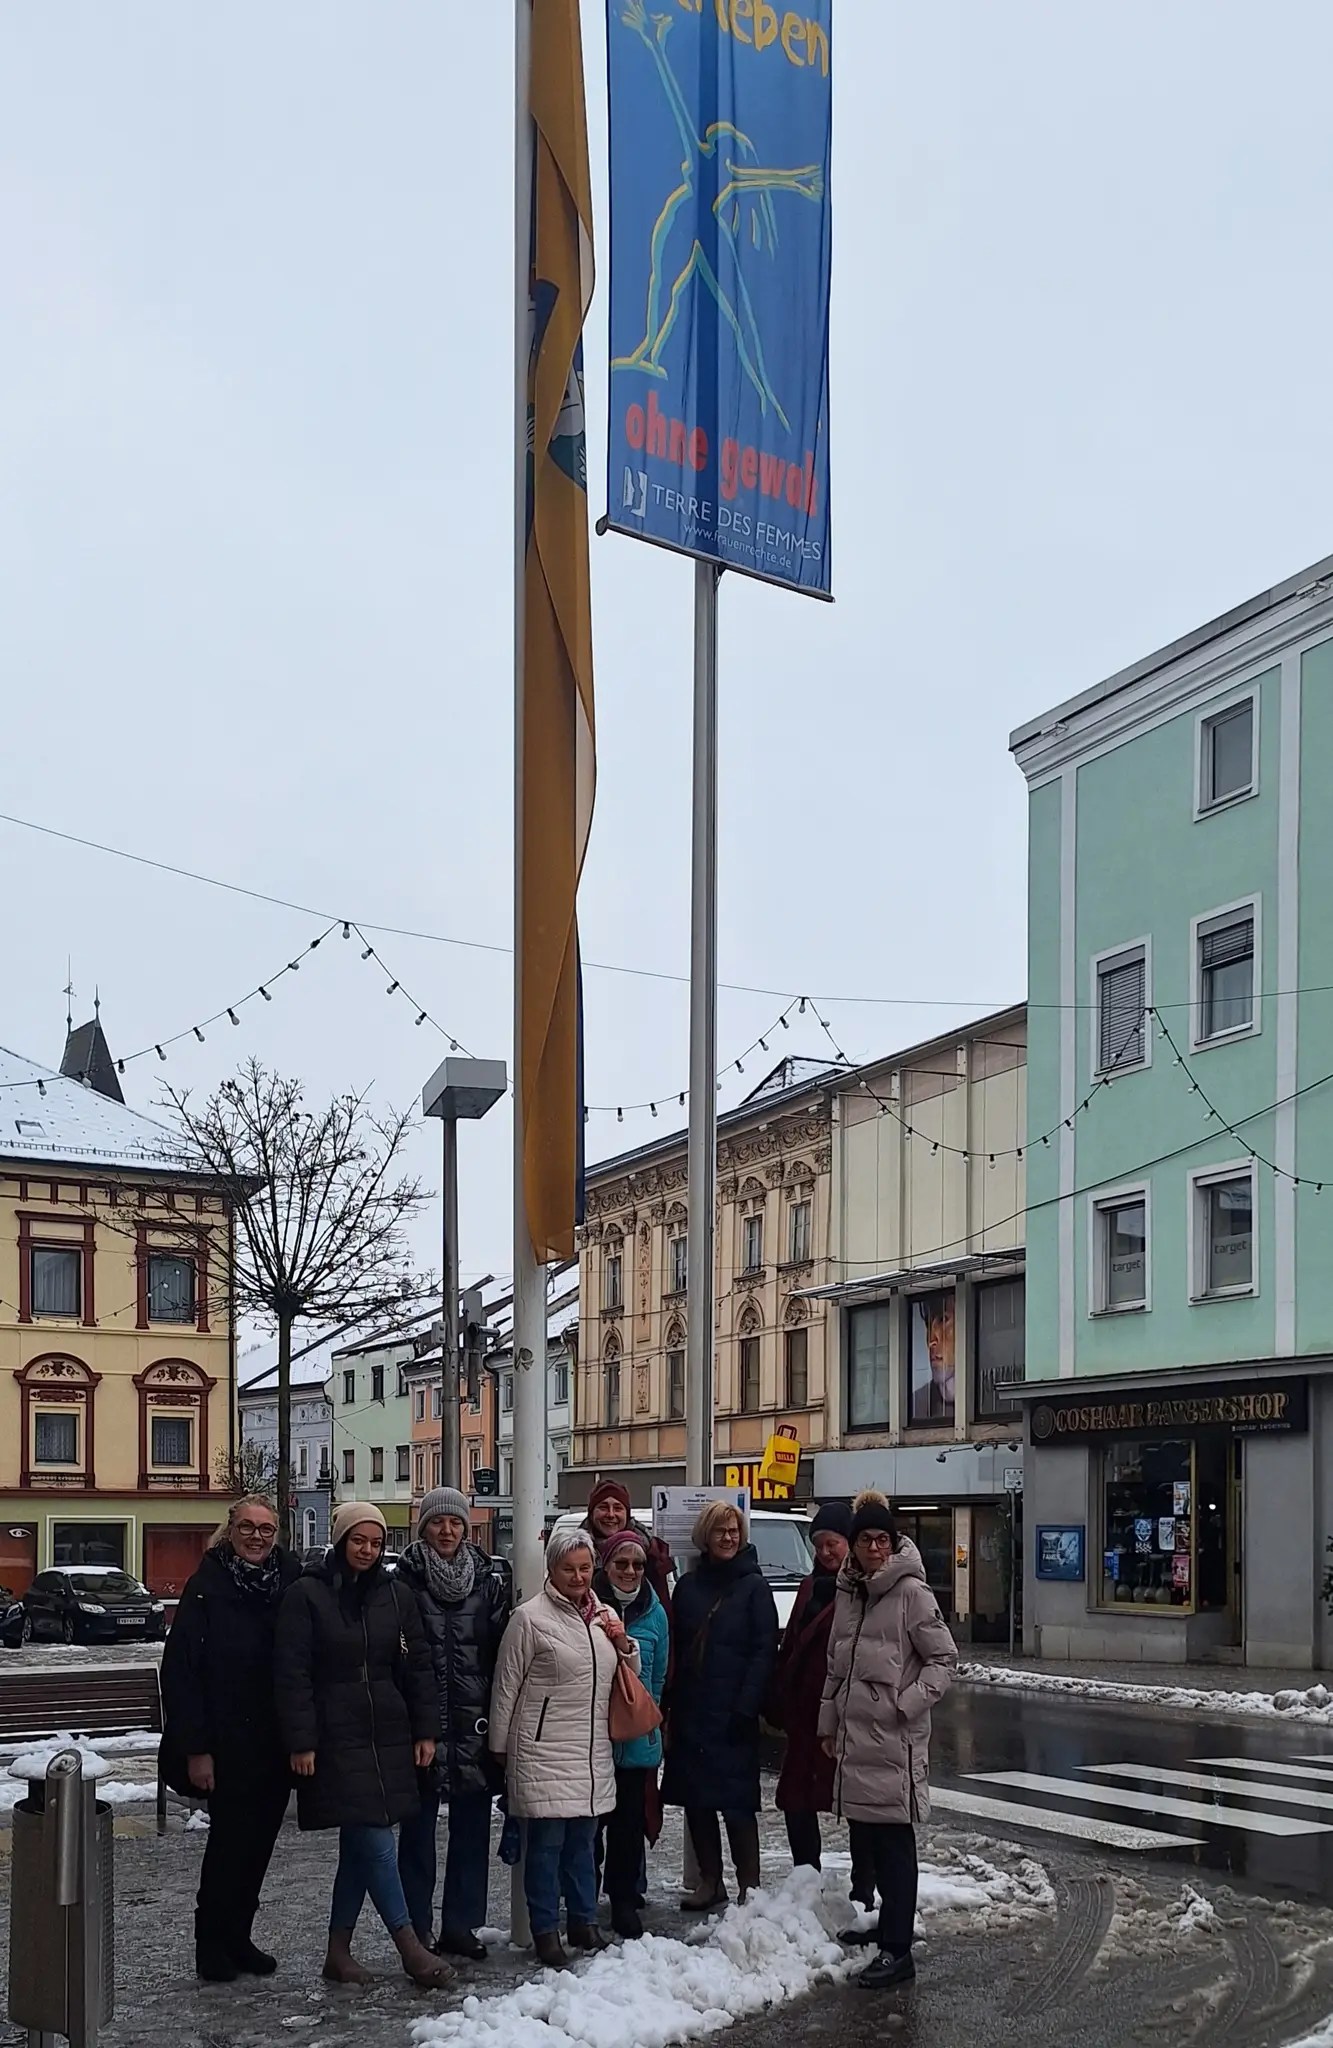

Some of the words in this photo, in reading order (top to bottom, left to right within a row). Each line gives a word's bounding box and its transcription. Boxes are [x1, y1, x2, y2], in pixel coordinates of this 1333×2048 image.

[625, 389, 708, 472] ohne
[651, 483, 712, 522] TERRE
[717, 506, 752, 536] DES
[756, 521, 821, 560] FEMMES
[683, 524, 792, 568] www.frauenrechte.de
[1214, 1240, 1247, 1255] target
[1112, 1259, 1141, 1273] target
[776, 1452, 795, 1462] BILLA
